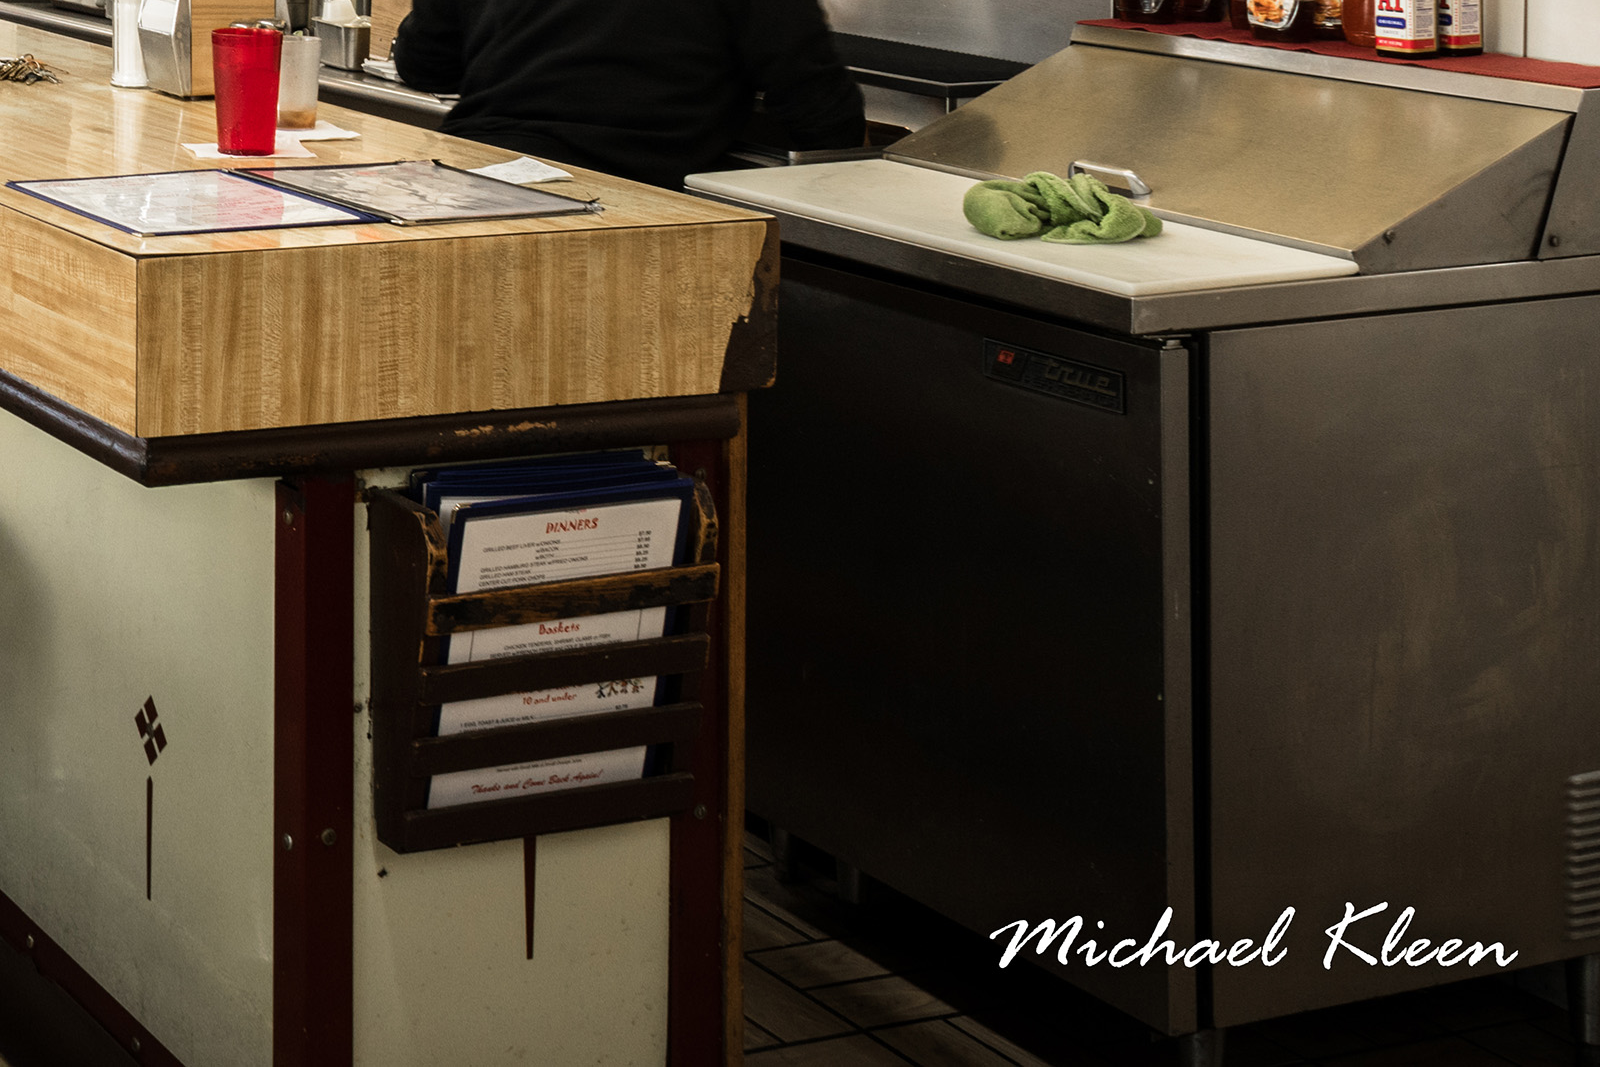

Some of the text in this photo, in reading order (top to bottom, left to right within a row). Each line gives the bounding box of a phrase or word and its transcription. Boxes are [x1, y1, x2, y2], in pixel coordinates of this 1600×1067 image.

[545, 517, 599, 534] DINNERS
[539, 621, 581, 635] Baskets
[522, 692, 577, 705] 10 and under
[471, 783, 501, 794] Thanks
[503, 781, 521, 791] and
